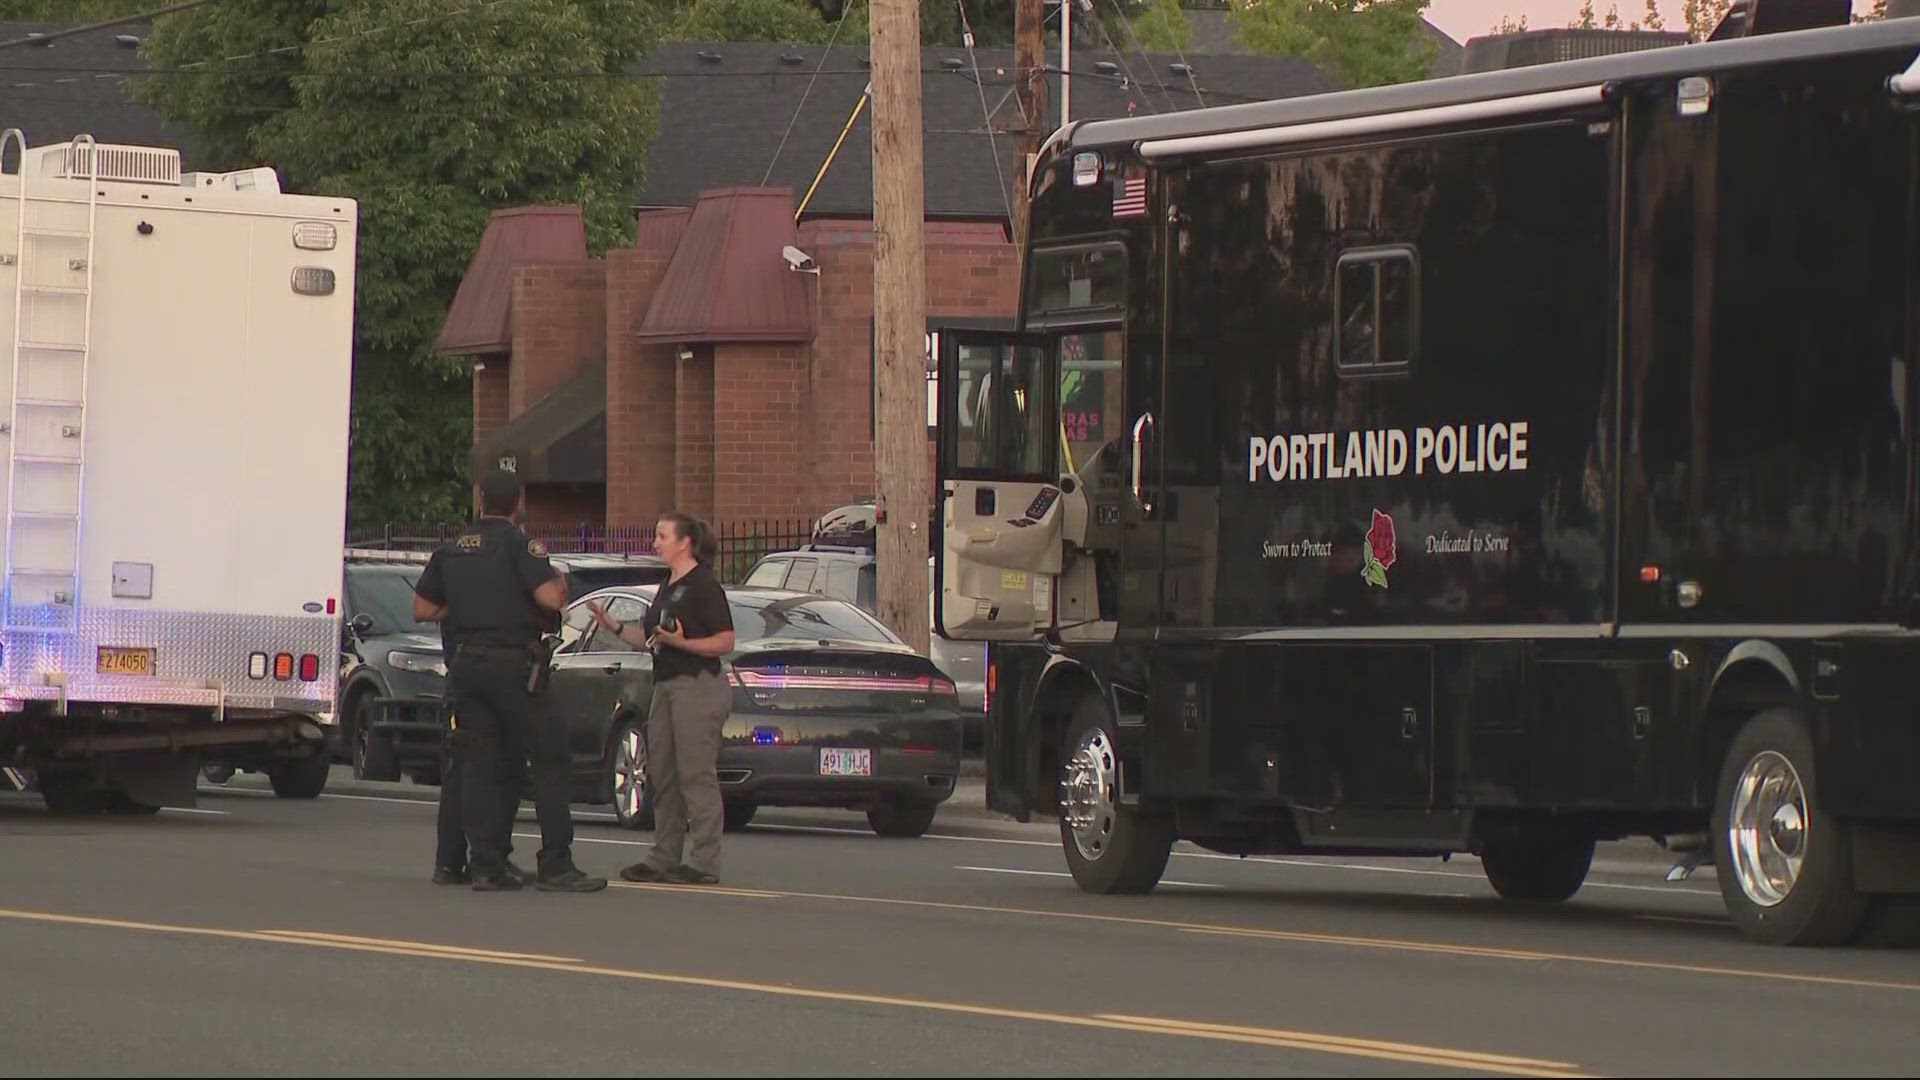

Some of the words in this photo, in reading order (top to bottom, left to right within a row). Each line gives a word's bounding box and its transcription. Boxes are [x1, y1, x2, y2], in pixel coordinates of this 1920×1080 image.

[1249, 428, 1409, 483] PORTLAND
[1415, 421, 1528, 475] POLICE
[1262, 540, 1289, 559] Sworn
[1290, 541, 1300, 558] to
[1301, 539, 1333, 558] Protect
[1425, 529, 1474, 553] Dedicated
[1473, 537, 1483, 552] to
[1484, 533, 1509, 553] Serve
[823, 754, 841, 769] 491
[849, 754, 869, 770] HJC
